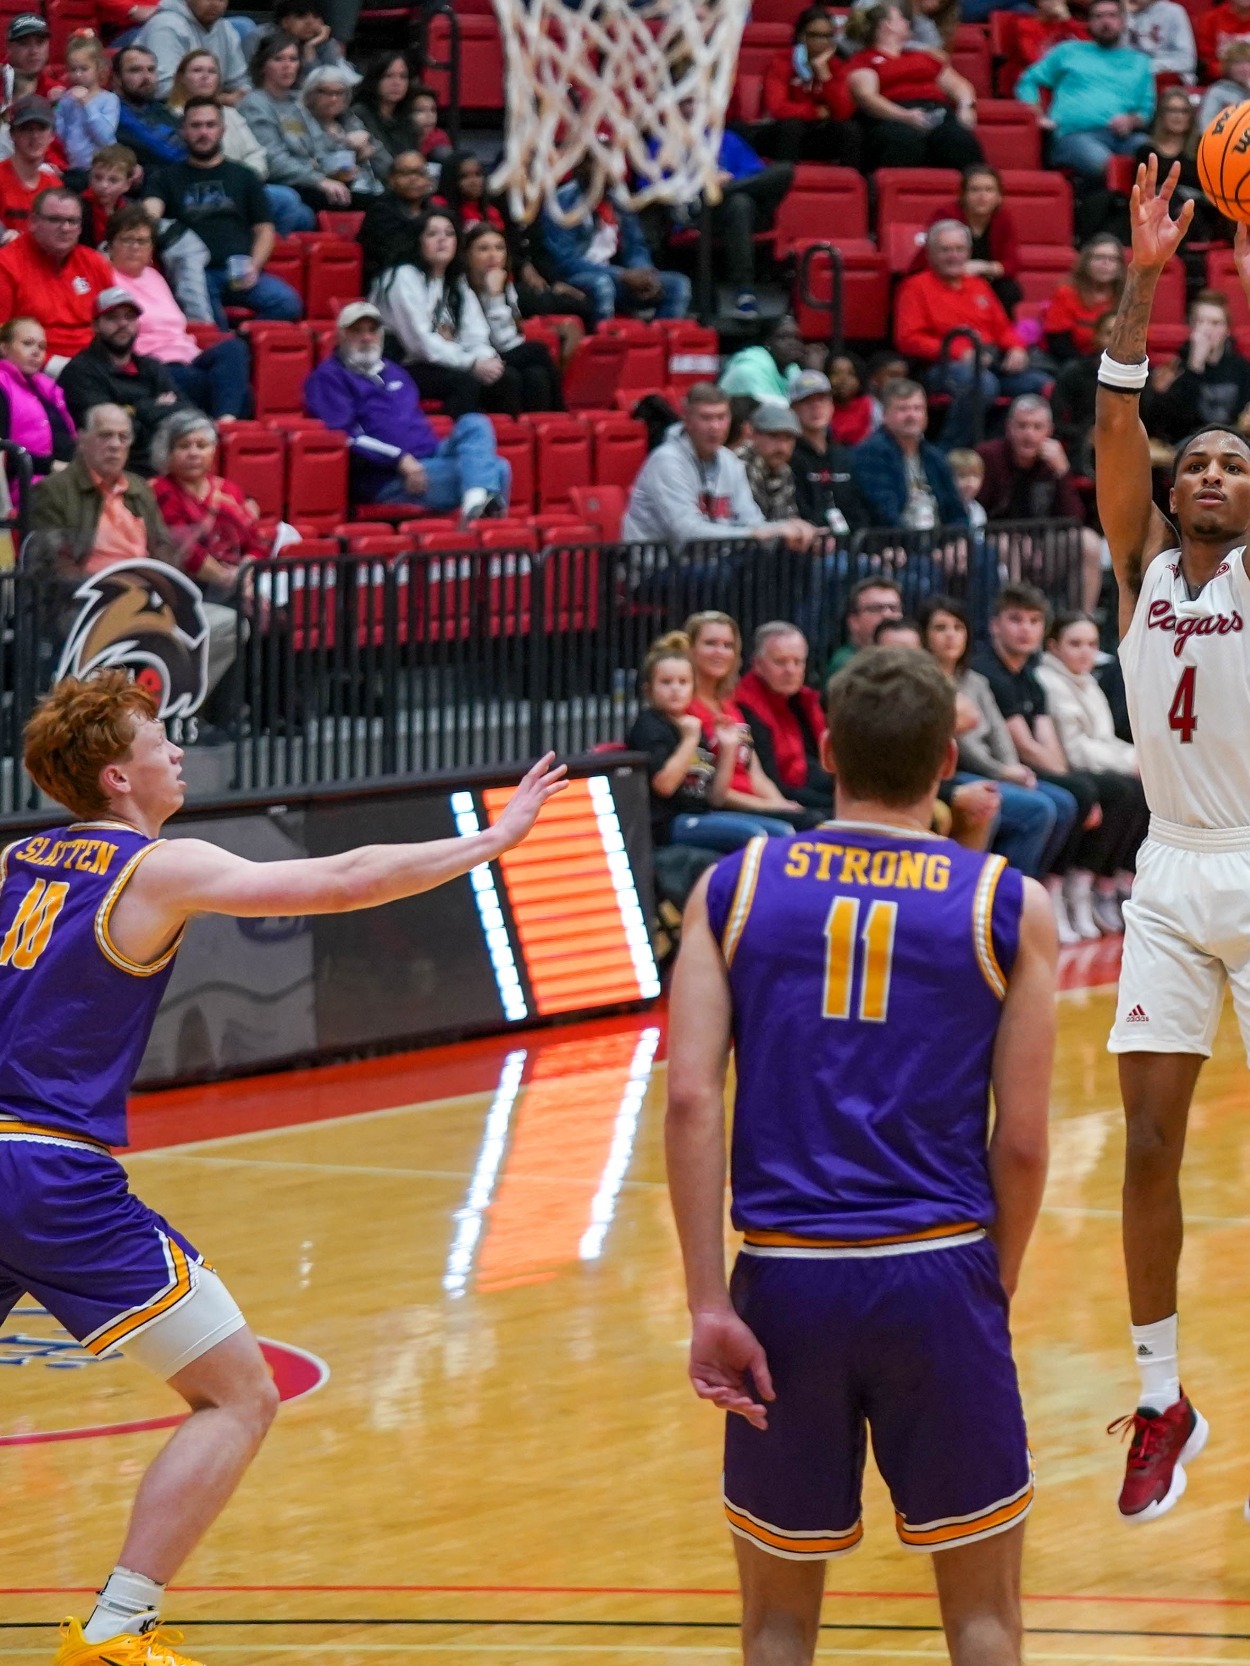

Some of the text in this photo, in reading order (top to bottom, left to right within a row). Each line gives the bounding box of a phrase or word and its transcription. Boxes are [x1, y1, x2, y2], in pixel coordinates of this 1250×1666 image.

[1168, 666, 1198, 744] 4
[15, 837, 120, 875] SLATTEN
[784, 842, 951, 892] STRONG
[0, 877, 70, 970] 10
[821, 895, 898, 1023] 11
